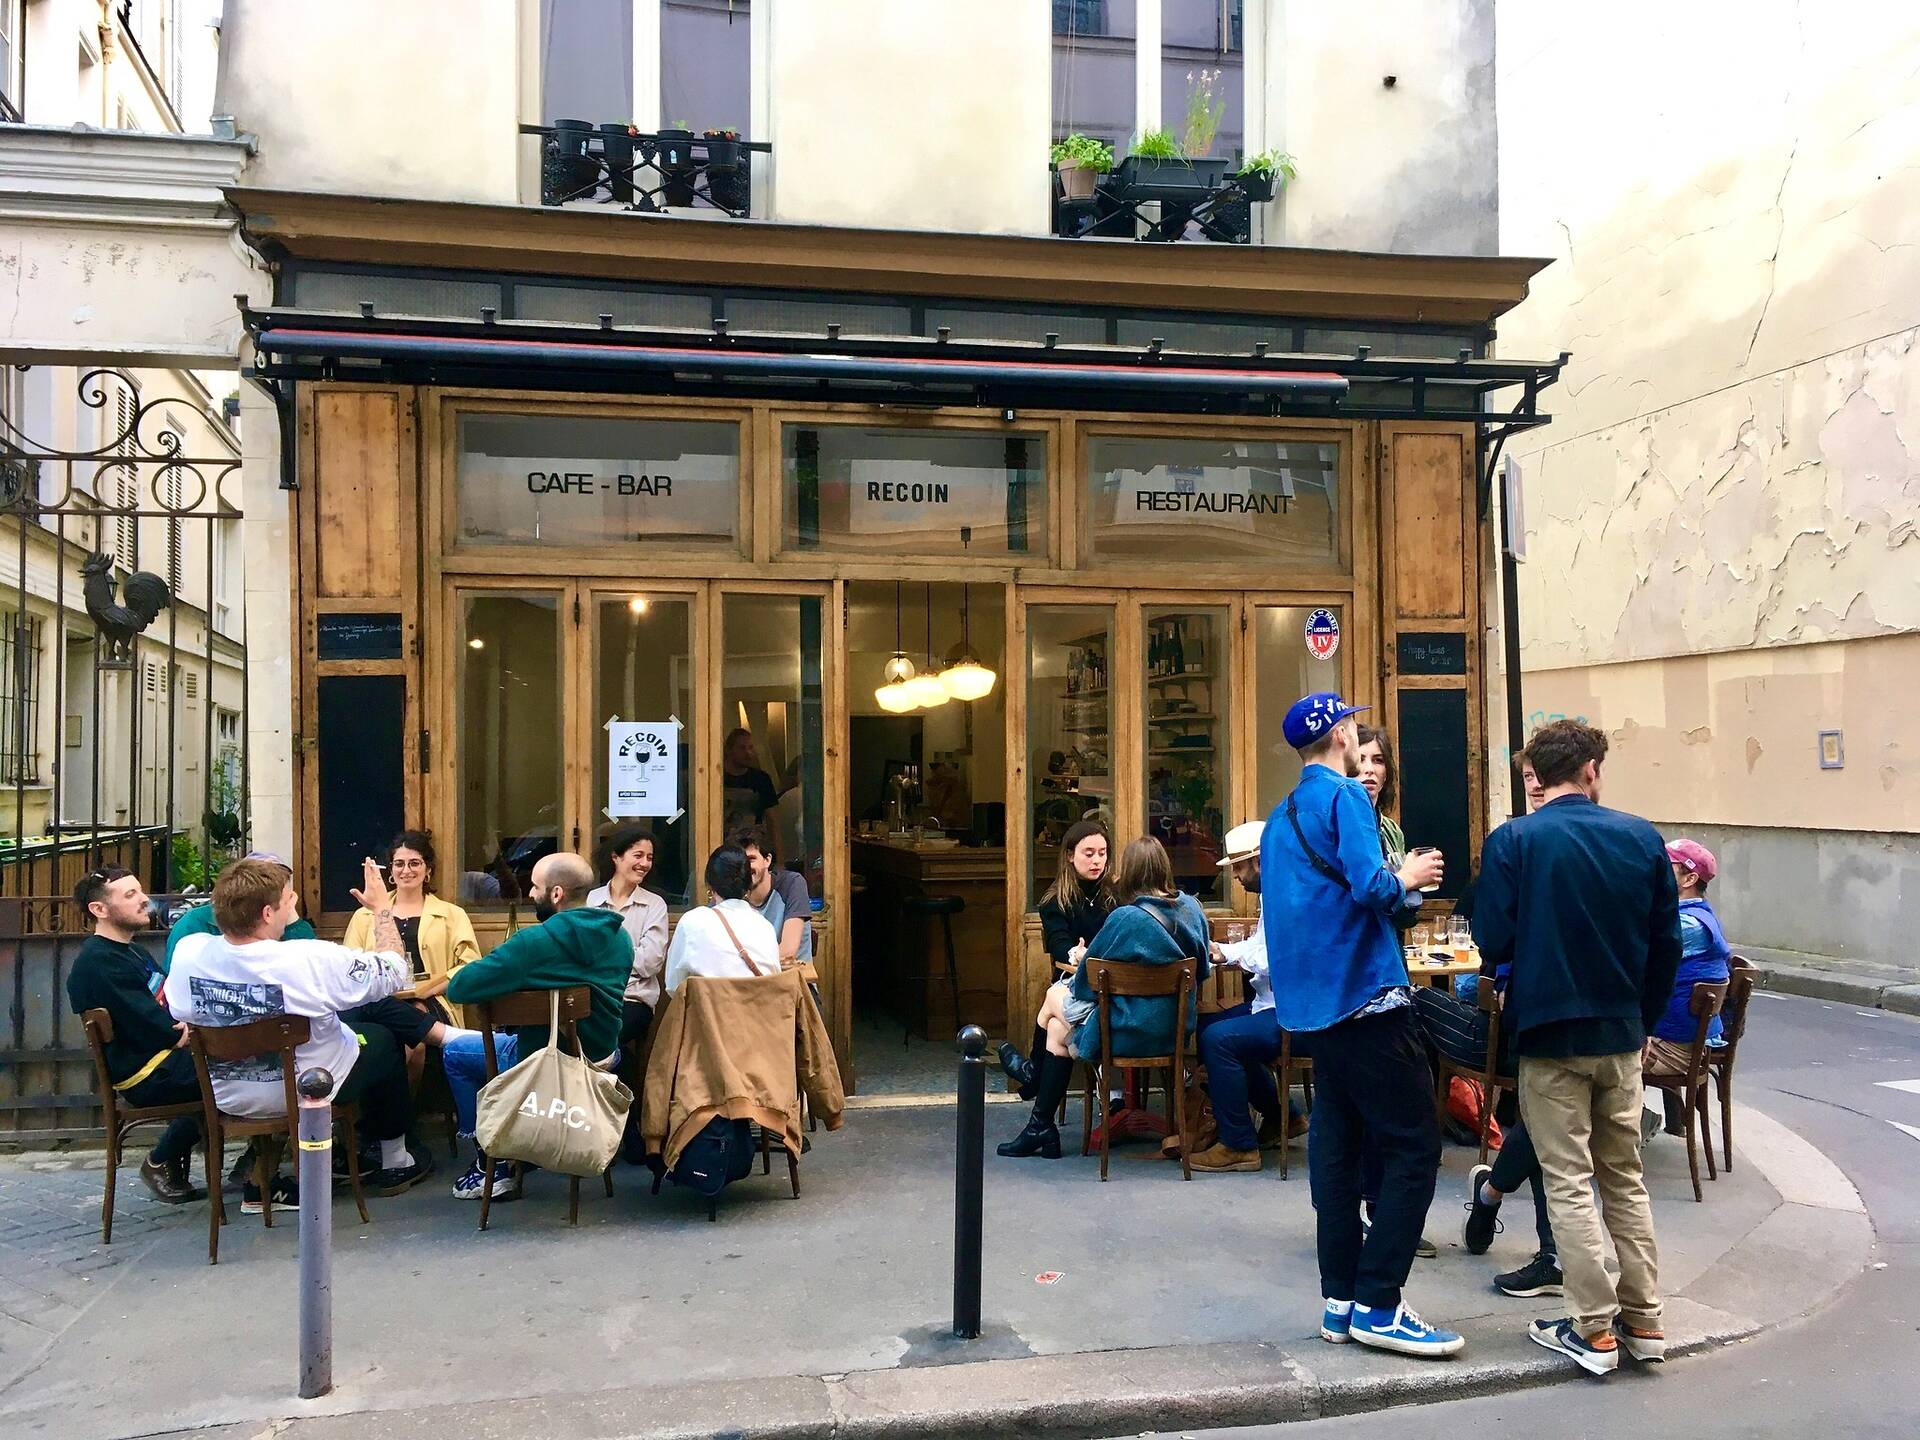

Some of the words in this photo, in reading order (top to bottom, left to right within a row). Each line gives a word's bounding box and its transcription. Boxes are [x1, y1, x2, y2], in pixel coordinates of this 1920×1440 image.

[528, 472, 594, 495] CAFE
[618, 474, 672, 496] BAR
[867, 481, 948, 503] RECOIN
[1136, 490, 1293, 514] RESTAURANT
[1316, 635, 1330, 648] IV
[619, 732, 667, 756] RECOIN
[518, 1091, 593, 1132] A.P.C.
